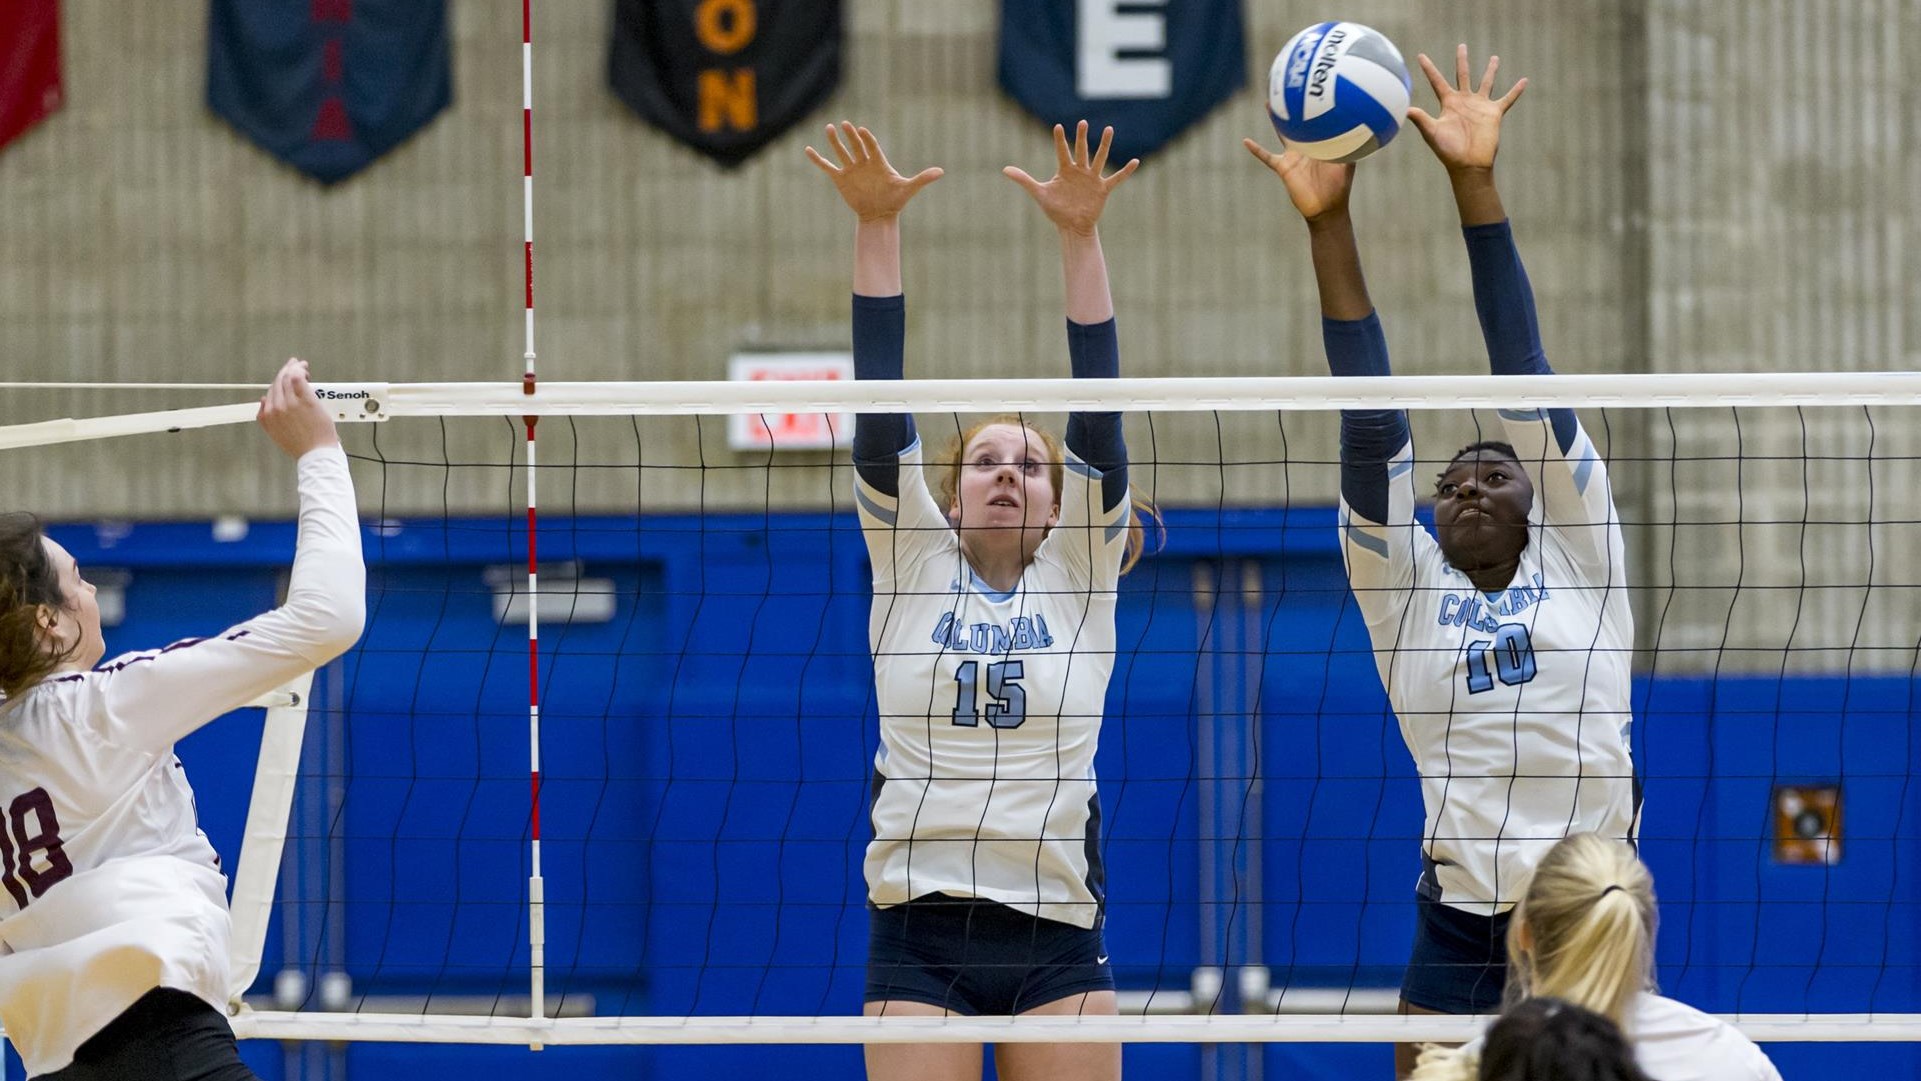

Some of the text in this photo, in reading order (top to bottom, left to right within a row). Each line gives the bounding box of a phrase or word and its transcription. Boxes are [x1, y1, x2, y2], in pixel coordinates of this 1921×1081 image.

[1075, 0, 1172, 99] E
[1309, 30, 1347, 97] molten
[327, 390, 370, 400] Senoh
[1466, 622, 1538, 695] 10
[952, 660, 1026, 729] 15
[0, 787, 73, 911] 18
